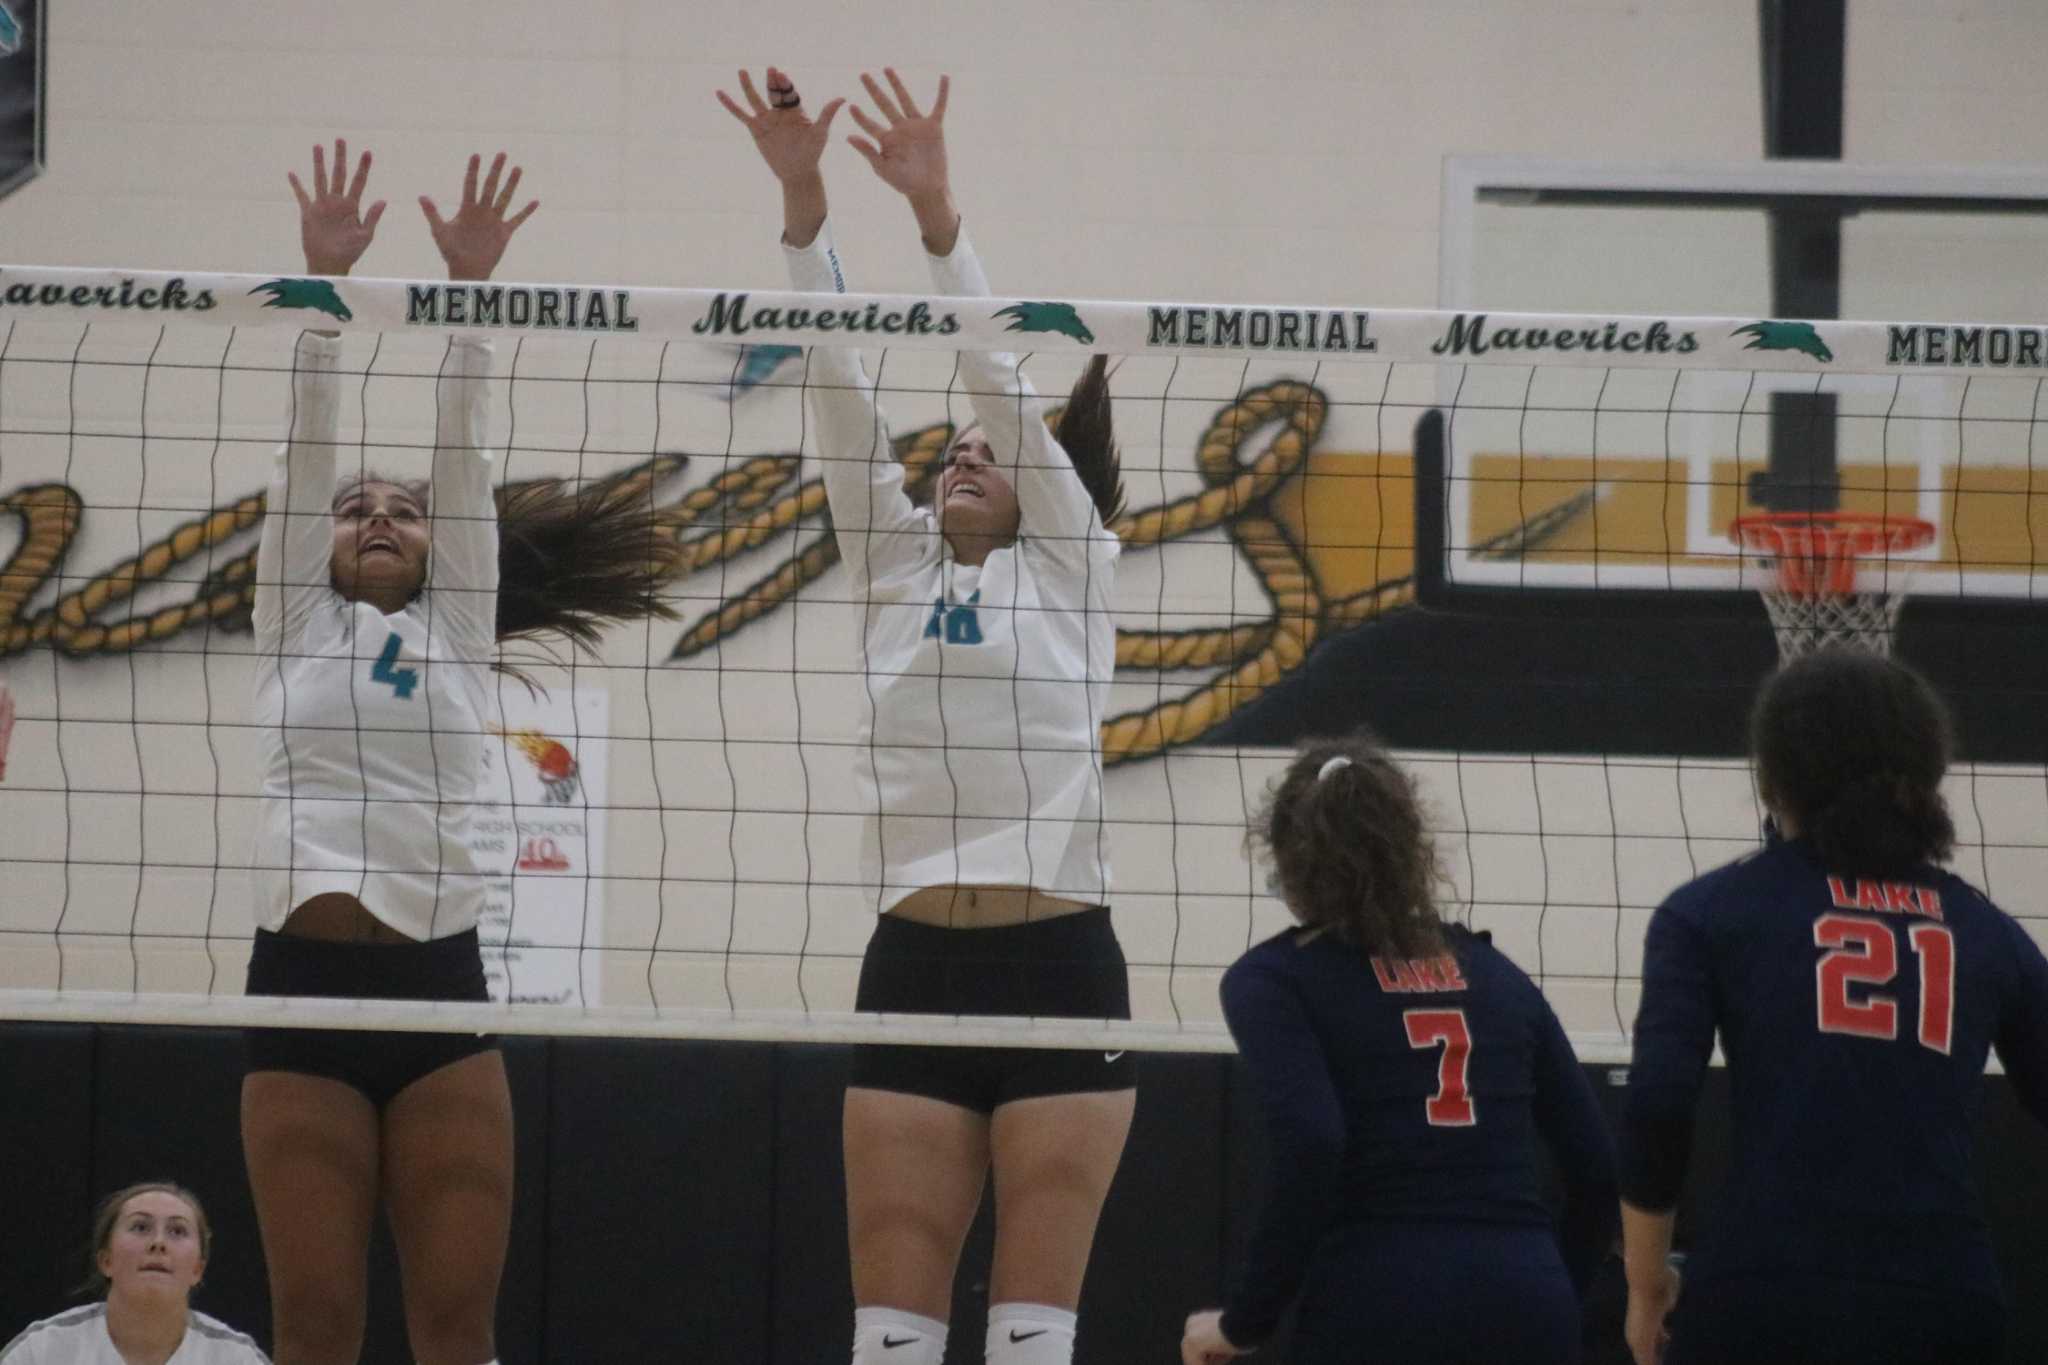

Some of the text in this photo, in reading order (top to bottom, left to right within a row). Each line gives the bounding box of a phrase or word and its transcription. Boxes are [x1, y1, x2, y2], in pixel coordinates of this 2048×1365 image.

[0, 276, 2048, 368] avericks MEMORIAL Mavericks MEMORIAL Mavericks MEMOR
[372, 631, 418, 701] 4
[1827, 875, 1945, 923] LAKE
[1370, 952, 1467, 993] LAKE
[1813, 912, 1955, 1056] 21
[1403, 1008, 1476, 1127] 7
